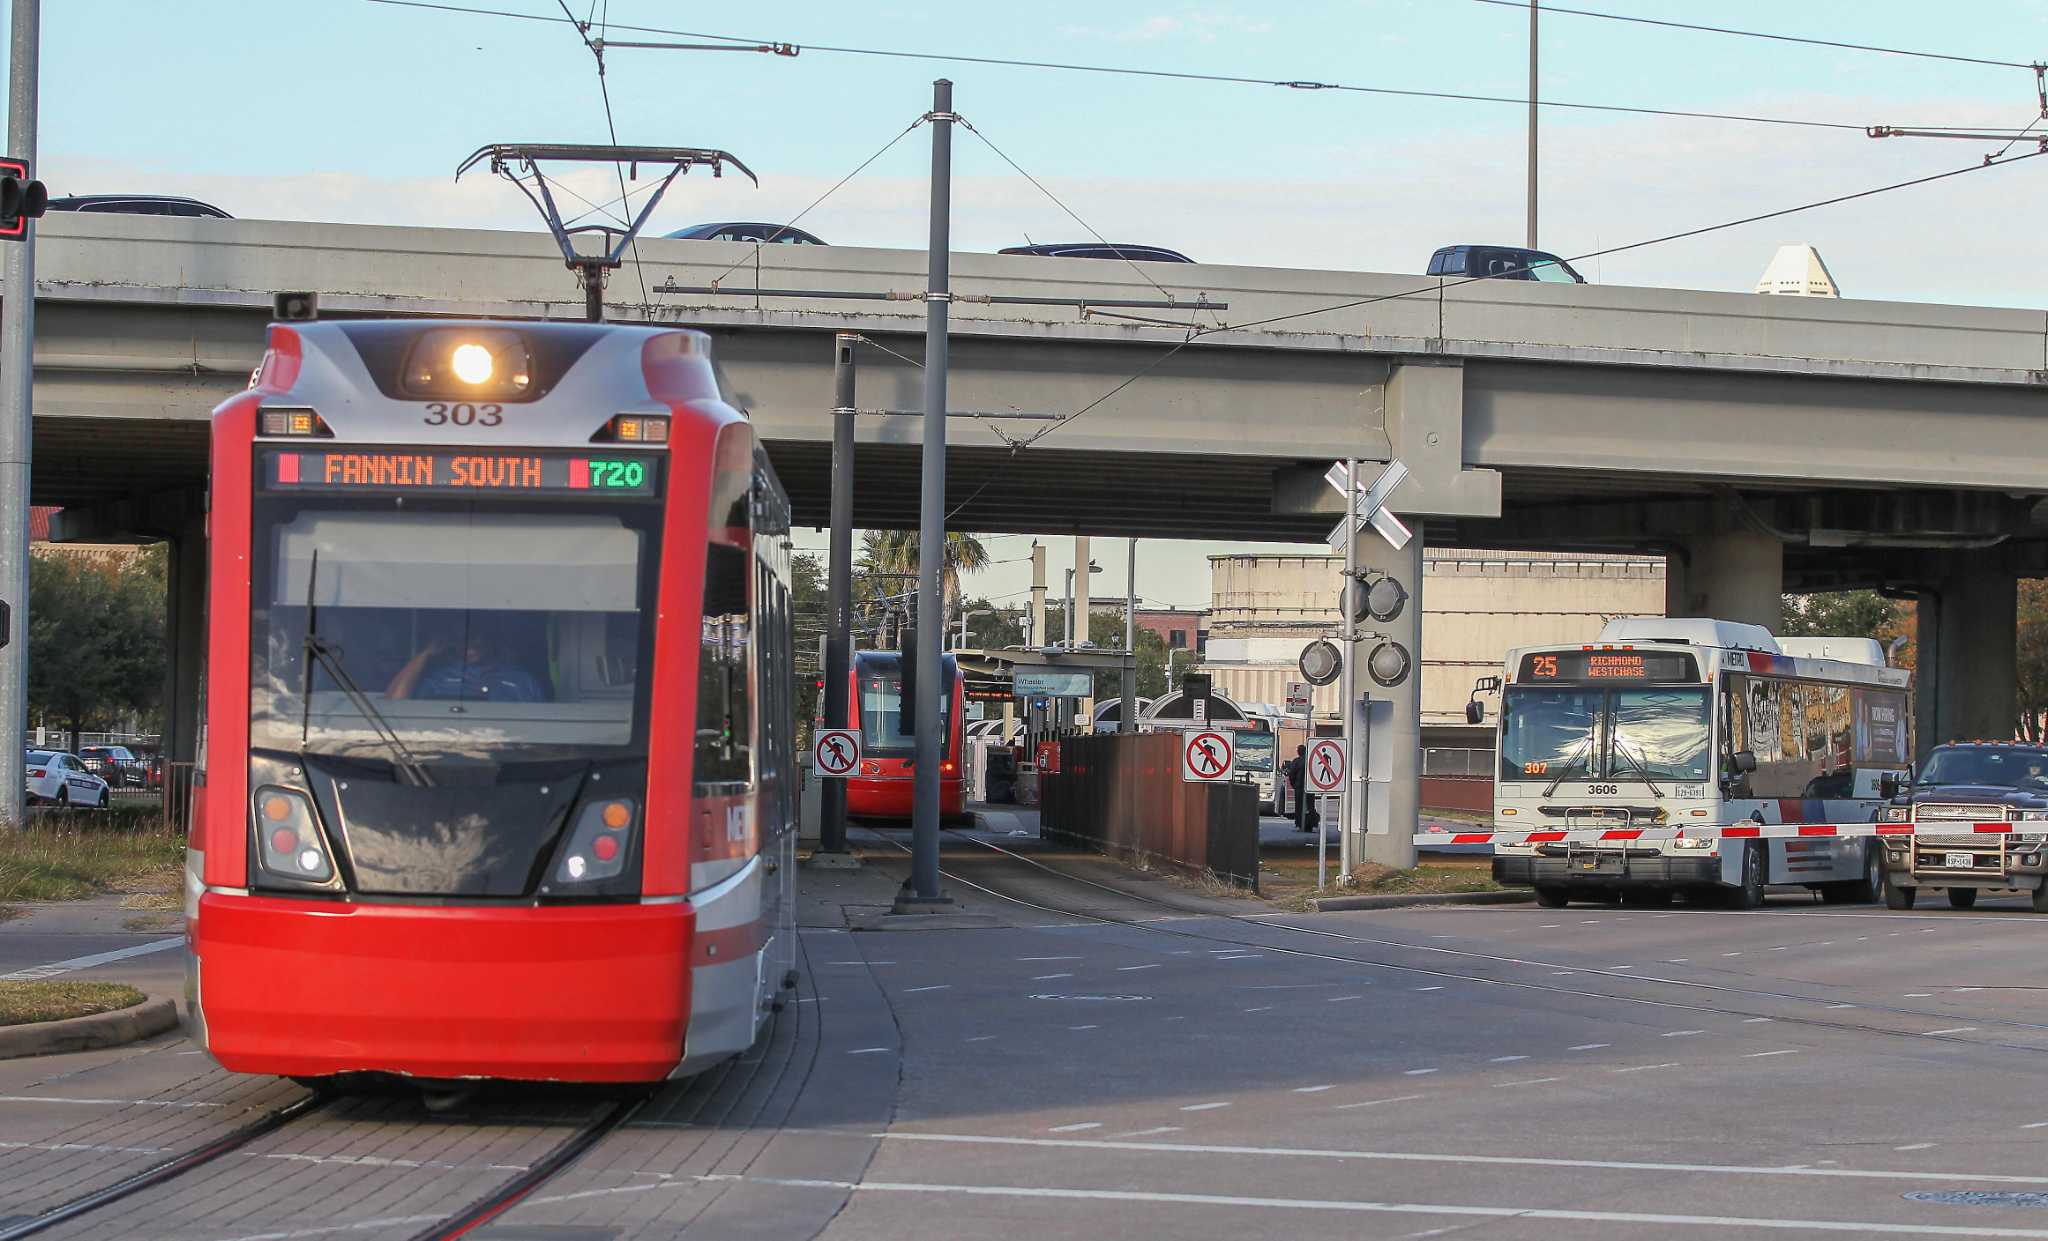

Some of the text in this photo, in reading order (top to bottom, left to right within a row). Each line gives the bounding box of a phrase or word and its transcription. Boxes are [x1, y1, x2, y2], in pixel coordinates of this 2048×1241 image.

[423, 403, 504, 427] 303
[325, 453, 542, 489] FANNIN SOUTH
[588, 460, 644, 488] 720
[1532, 655, 1558, 678] 25
[1589, 656, 1643, 667] RICHMOND
[1587, 666, 1646, 678] WESTCHASE
[1523, 762, 1548, 775] 307
[1588, 784, 1618, 795] 3606
